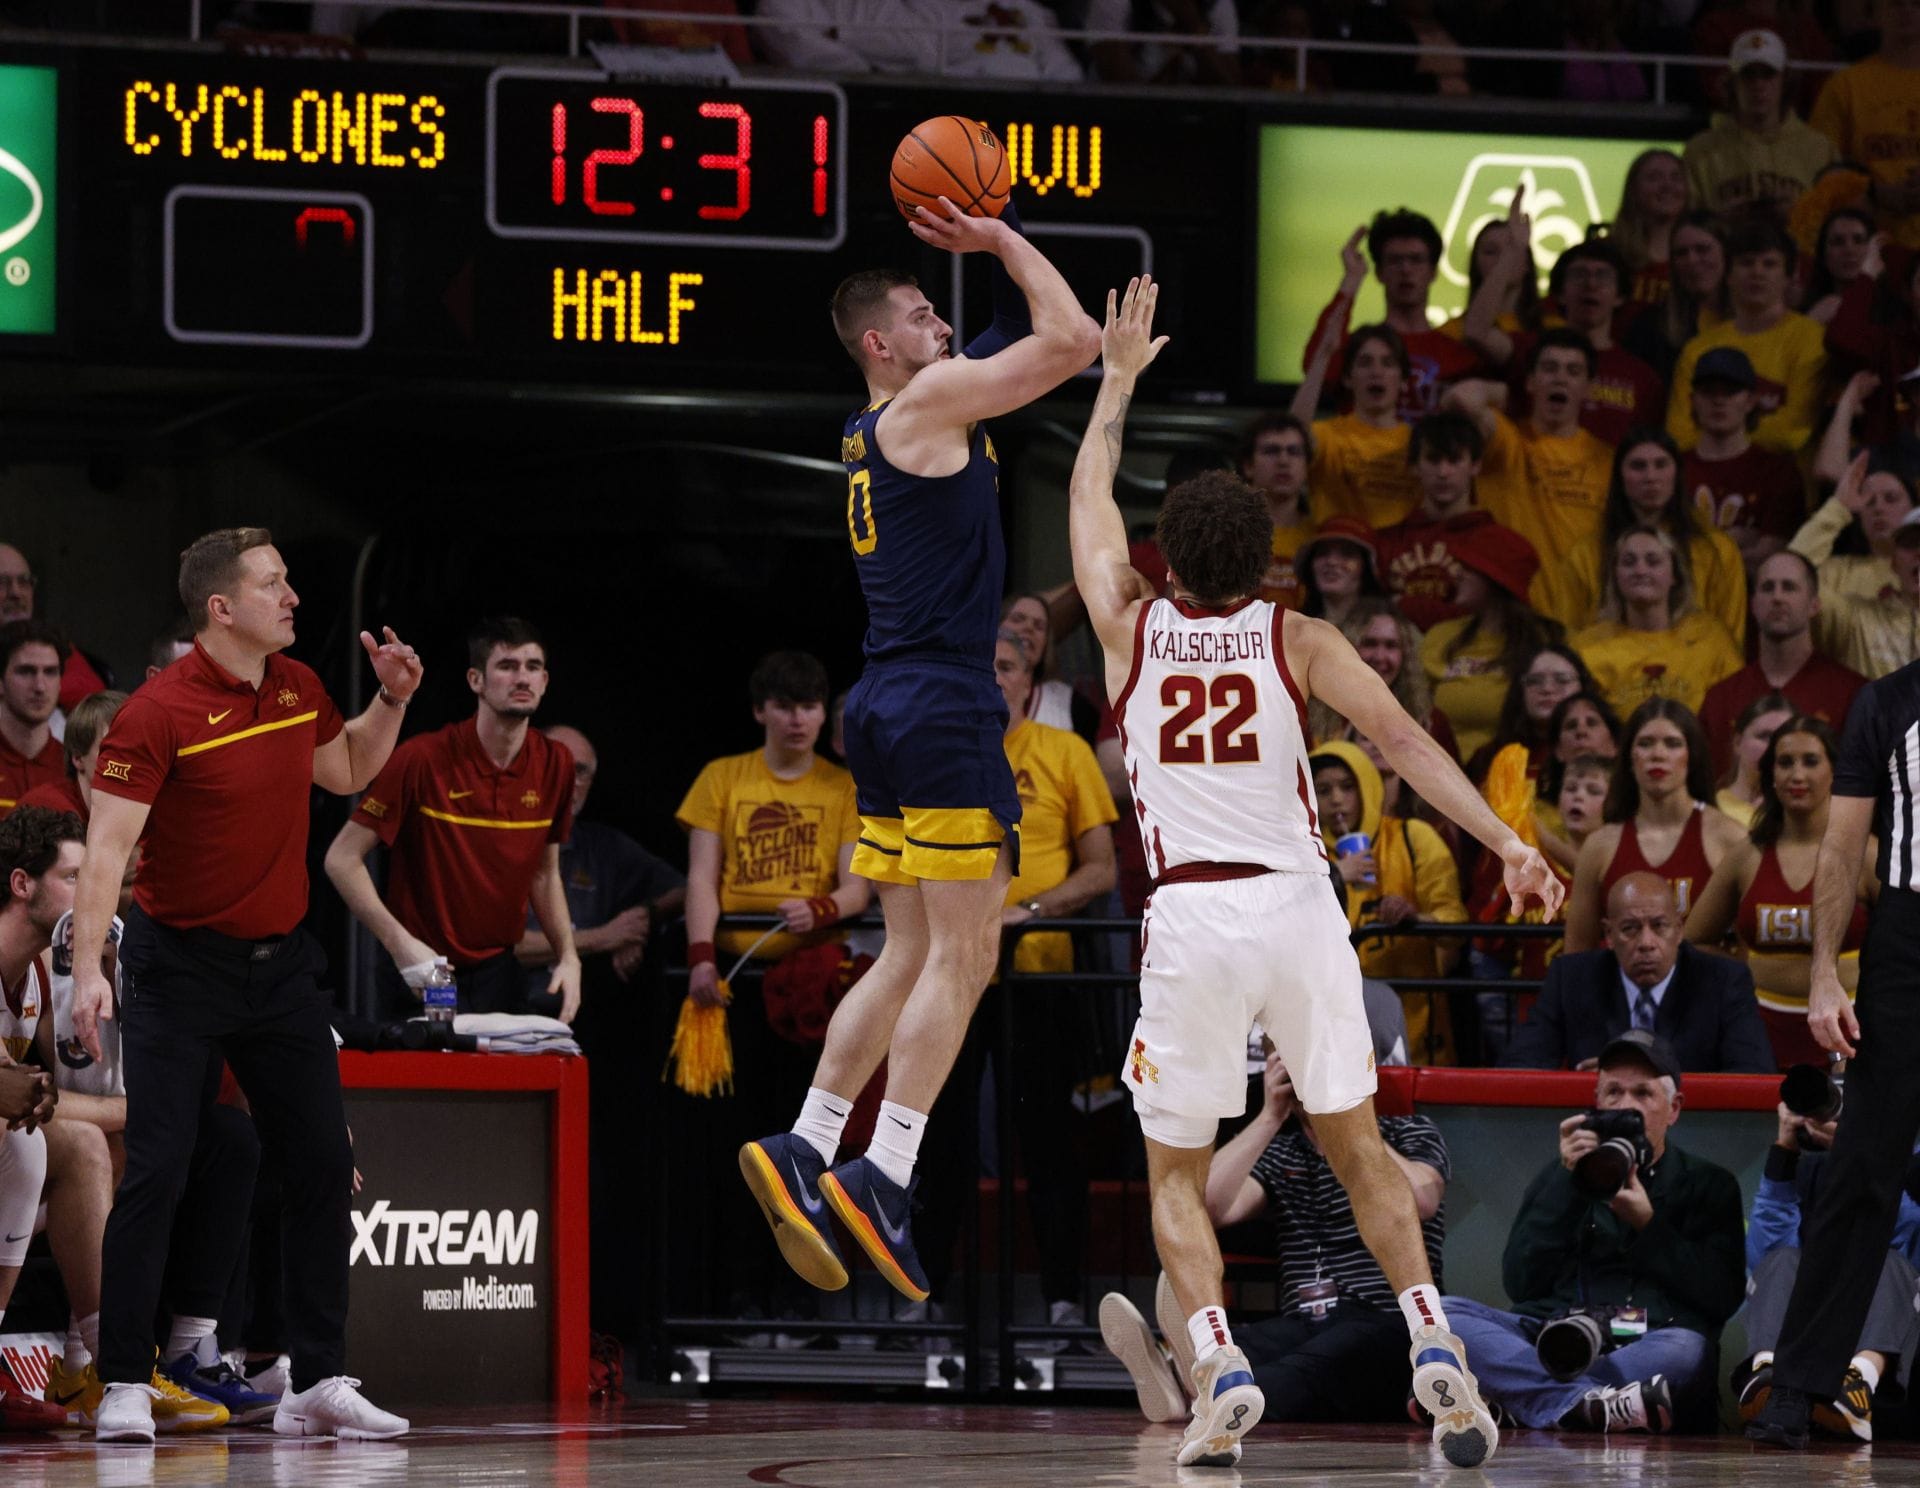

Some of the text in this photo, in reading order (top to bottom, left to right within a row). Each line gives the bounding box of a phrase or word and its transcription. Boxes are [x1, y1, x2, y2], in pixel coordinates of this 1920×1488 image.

[125, 81, 445, 168] CYCLONES
[551, 98, 827, 220] 12:31
[552, 267, 703, 345] HALF
[848, 469, 878, 556] 0
[1149, 629, 1266, 664] KALSCHEUR
[1158, 672, 1262, 765] 22
[736, 822, 817, 862] CYCLONE
[349, 1200, 540, 1266] XTREAM
[423, 1274, 535, 1311] POWERED BY Mediacom
